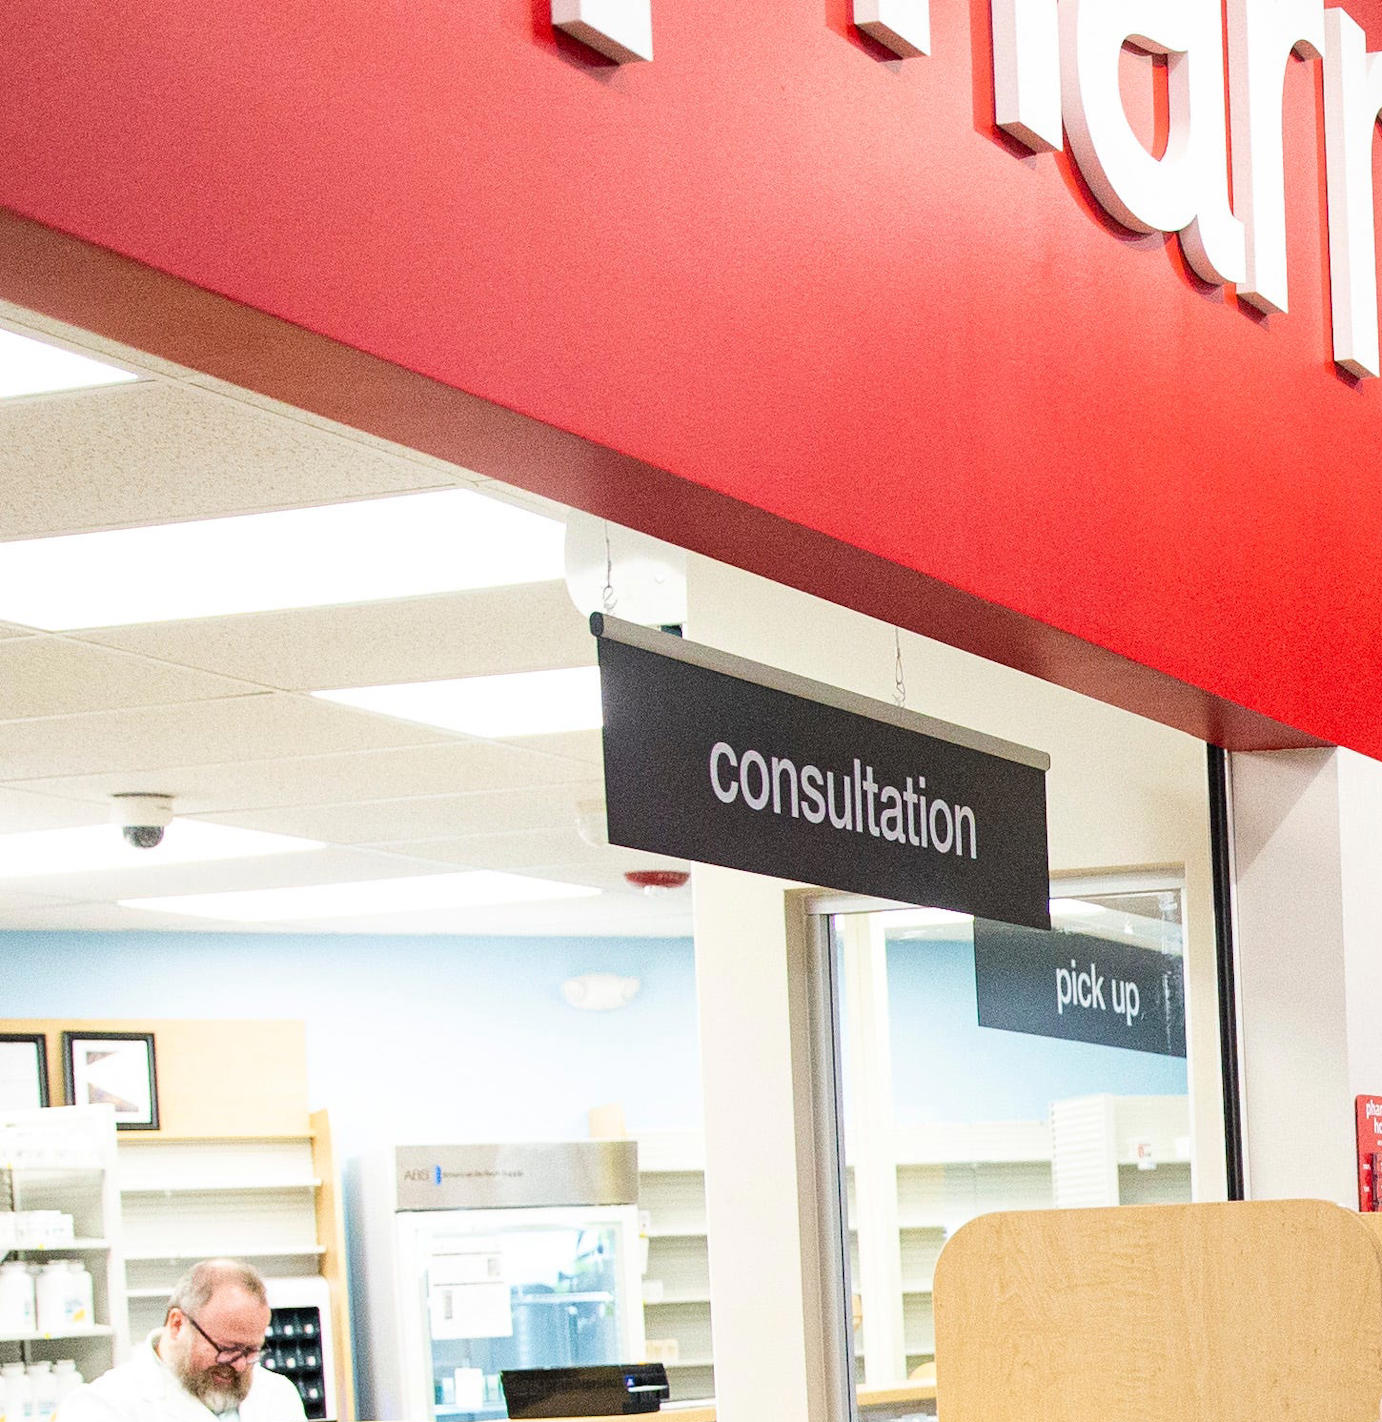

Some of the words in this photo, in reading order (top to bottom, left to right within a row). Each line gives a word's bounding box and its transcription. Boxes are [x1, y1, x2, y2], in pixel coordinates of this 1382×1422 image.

[708, 739, 978, 860] consultation
[1055, 959, 1106, 1017] pick
[1111, 977, 1140, 1027] up
